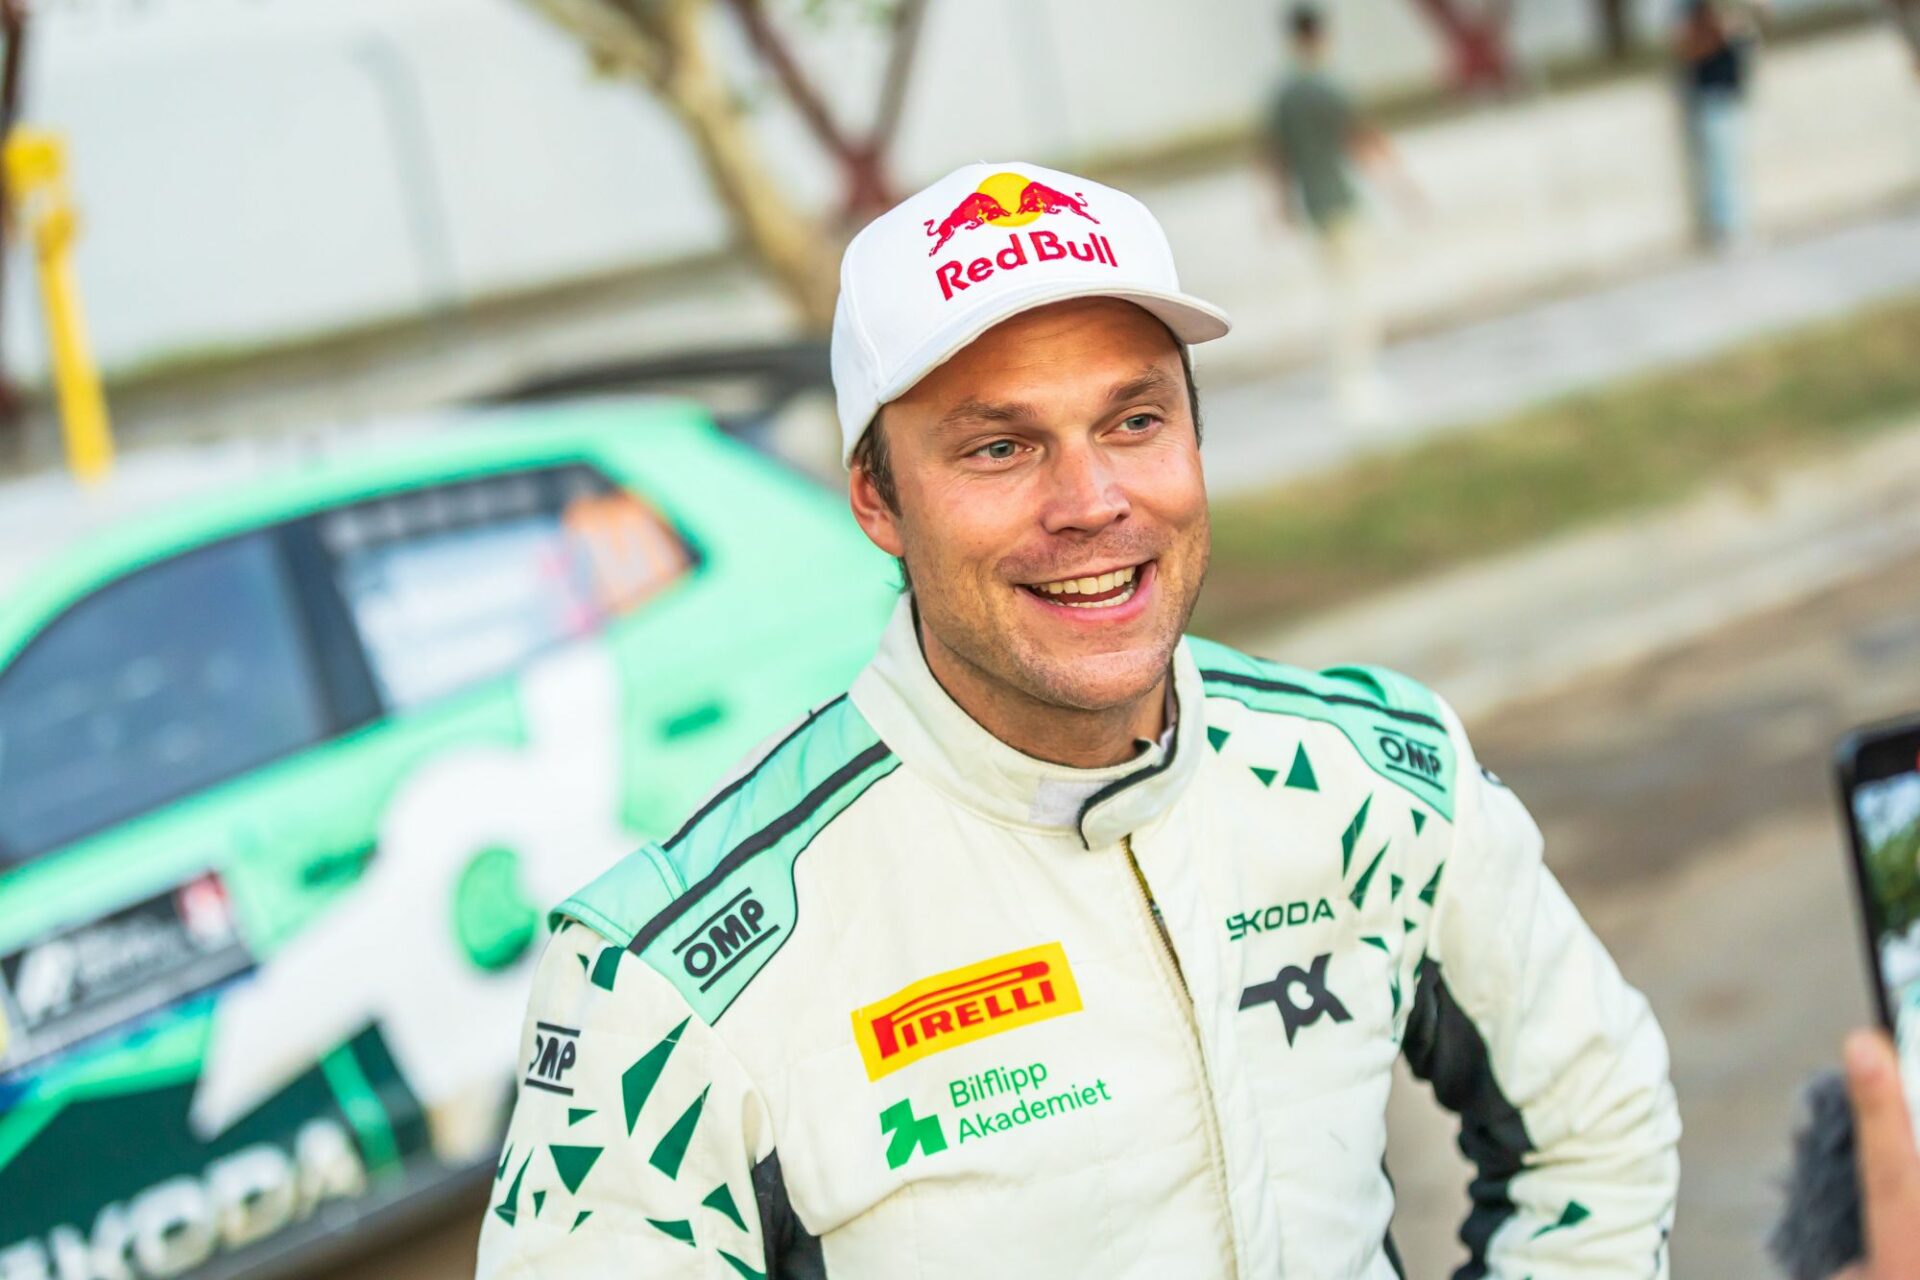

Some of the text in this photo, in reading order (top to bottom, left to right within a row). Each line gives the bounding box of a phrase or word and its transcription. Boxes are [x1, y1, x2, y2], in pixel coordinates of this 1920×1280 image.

[936, 230, 1119, 301] Red Bull
[1379, 736, 1442, 778] OMP
[683, 898, 764, 978] OMP
[871, 961, 1057, 1060] PIRELLI
[949, 1062, 1048, 1108] Bilflipp
[958, 1078, 1112, 1144] Akademiet
